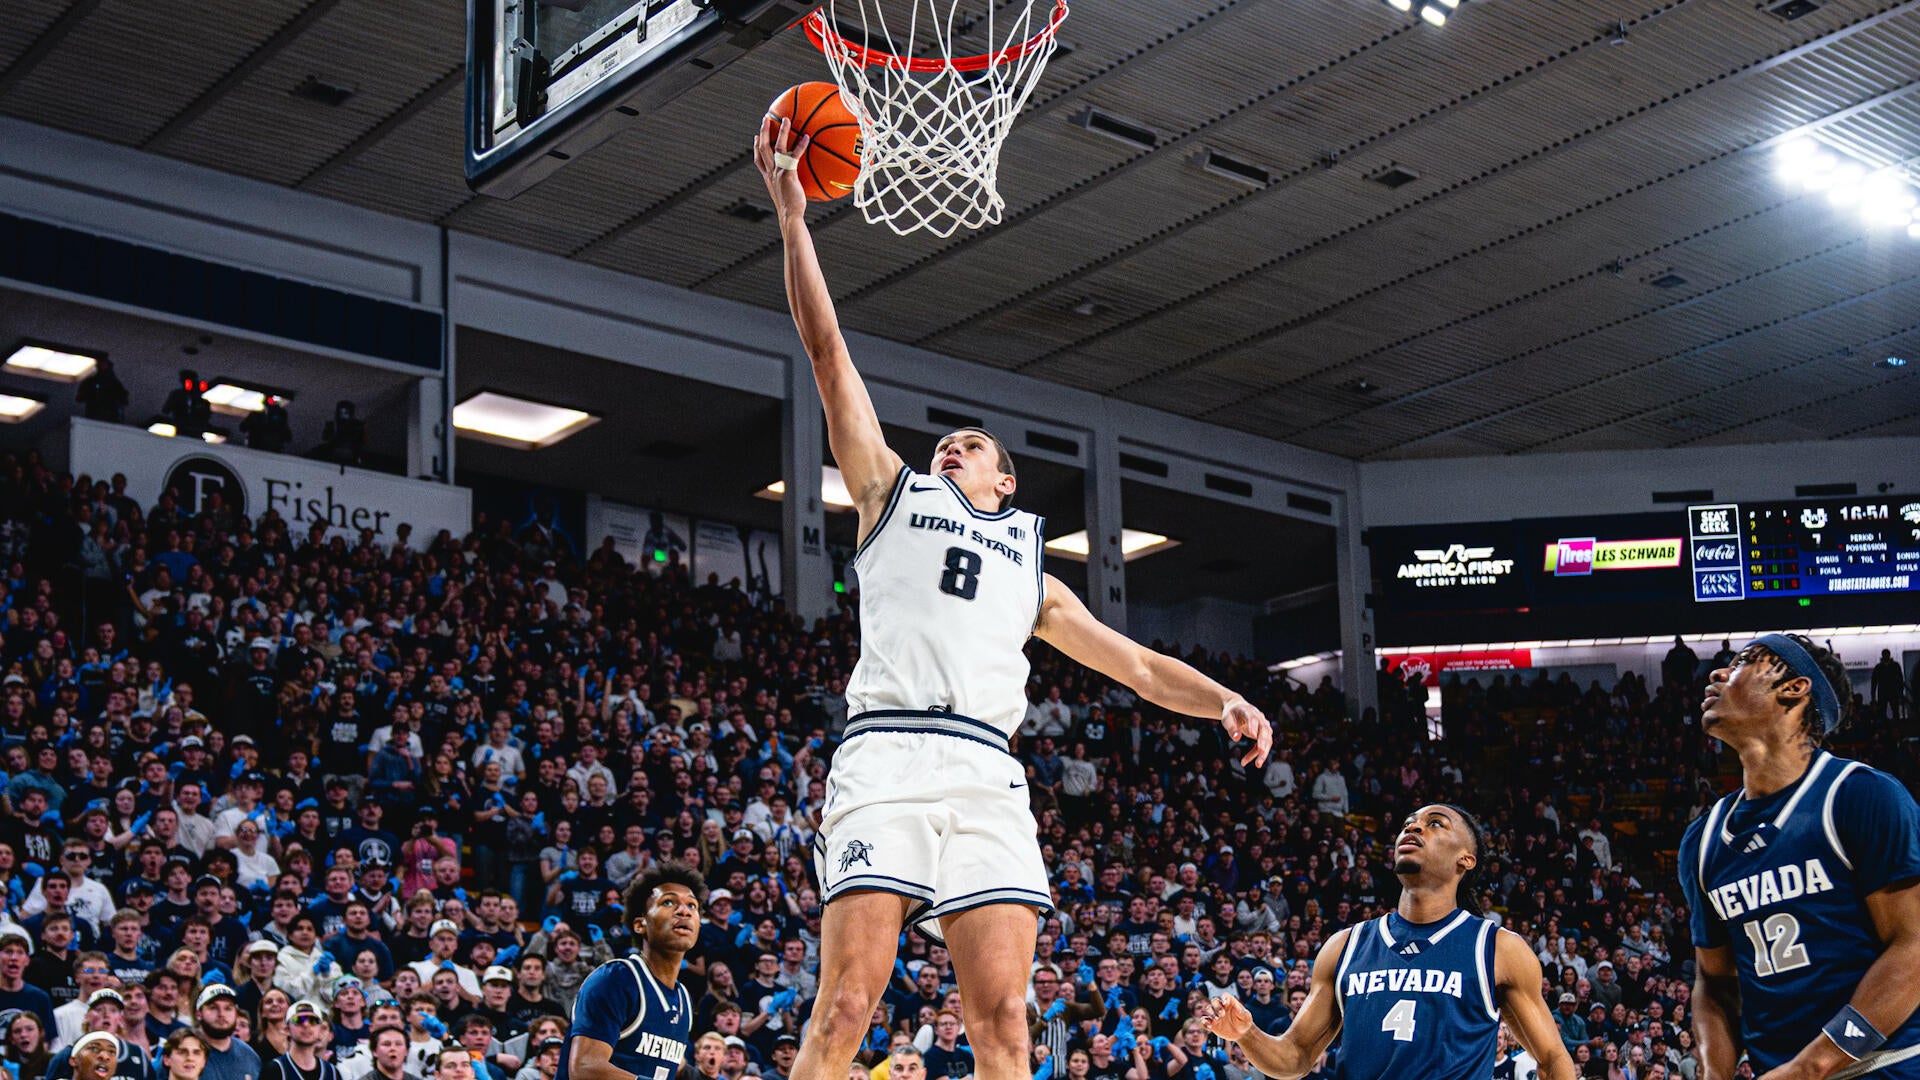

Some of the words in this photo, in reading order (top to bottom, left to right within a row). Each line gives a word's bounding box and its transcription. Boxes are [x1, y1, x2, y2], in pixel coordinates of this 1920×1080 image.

[189, 472, 224, 517] F
[263, 477, 390, 535] Fisher
[1701, 510, 1728, 522] SEAT
[1700, 521, 1729, 533] GEEK
[803, 526, 820, 546] M
[909, 513, 965, 537] UTAH
[971, 529, 1023, 567] STATE
[1850, 533, 1874, 542] PERIOD
[1559, 543, 1594, 567] Tires
[1595, 549, 1616, 562] LES
[1620, 546, 1675, 561] SCHWAB
[1846, 543, 1887, 552] POSSESSION
[1816, 556, 1839, 564] BONUS
[1861, 556, 1874, 564] TOL
[1896, 552, 1920, 560] BONUS
[938, 545, 982, 602] 8
[1397, 562, 1467, 578] AMERICA
[1468, 560, 1514, 575] FIRST
[1820, 567, 1842, 575] FOULS
[1896, 564, 1919, 572] FOULS
[1415, 577, 1456, 587] CREDIT
[1461, 575, 1497, 586] UNION
[1701, 573, 1737, 585] ZIONS
[1110, 586, 1122, 603] N
[1702, 584, 1736, 594] BANK
[1362, 633, 1371, 648] P
[1708, 858, 1834, 920] NEVADA
[1743, 913, 1810, 977] 12
[1345, 968, 1462, 999] NEVADA
[1382, 999, 1416, 1042] 4
[635, 1031, 688, 1065] NEVAD
